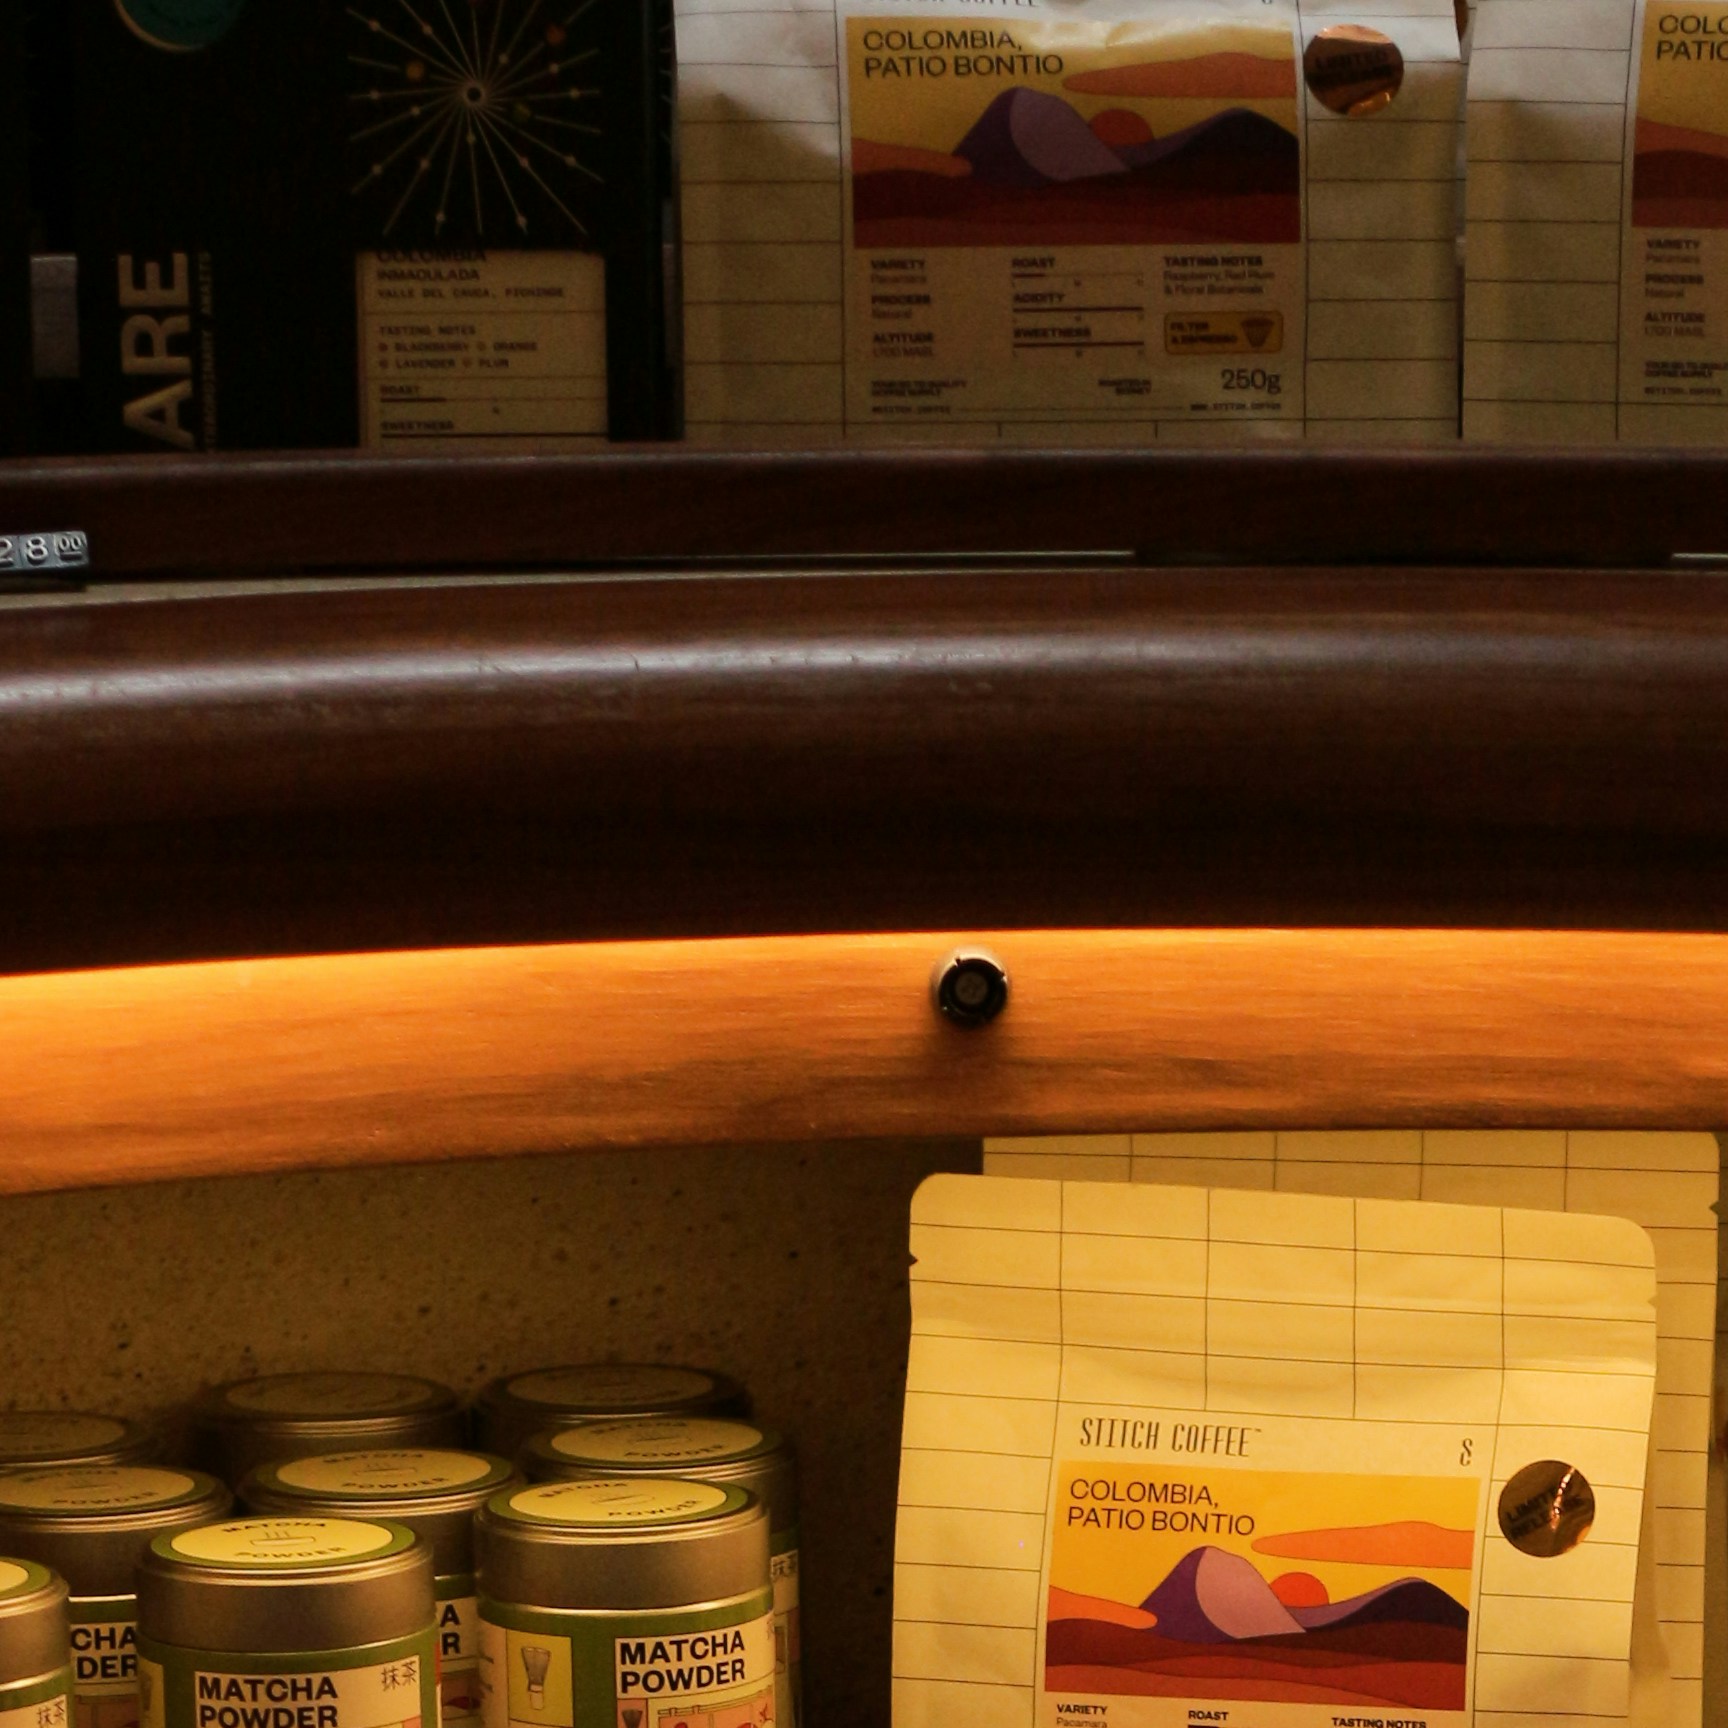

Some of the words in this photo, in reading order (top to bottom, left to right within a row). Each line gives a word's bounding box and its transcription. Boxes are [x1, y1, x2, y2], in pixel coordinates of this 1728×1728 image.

[863, 30, 1022, 51] COLOMBIA,
[863, 55, 947, 78] PATIO
[954, 54, 1063, 76] BONTIO
[1221, 369, 1283, 394] 250g
[1080, 1418, 1158, 1450] STITCH
[1172, 1423, 1251, 1457] COFFEE
[1070, 1479, 1218, 1507] COLOMBIA,
[1068, 1507, 1144, 1530] PATIO
[1152, 1511, 1255, 1536] BONTIO
[620, 1630, 745, 1665] MATCHA
[621, 1659, 745, 1693] POWDER
[199, 1676, 338, 1702] MATCHA
[1057, 1704, 1107, 1715] VARIETY
[1188, 1711, 1229, 1721] ROAST
[1332, 1717, 1384, 1728] TASTING
